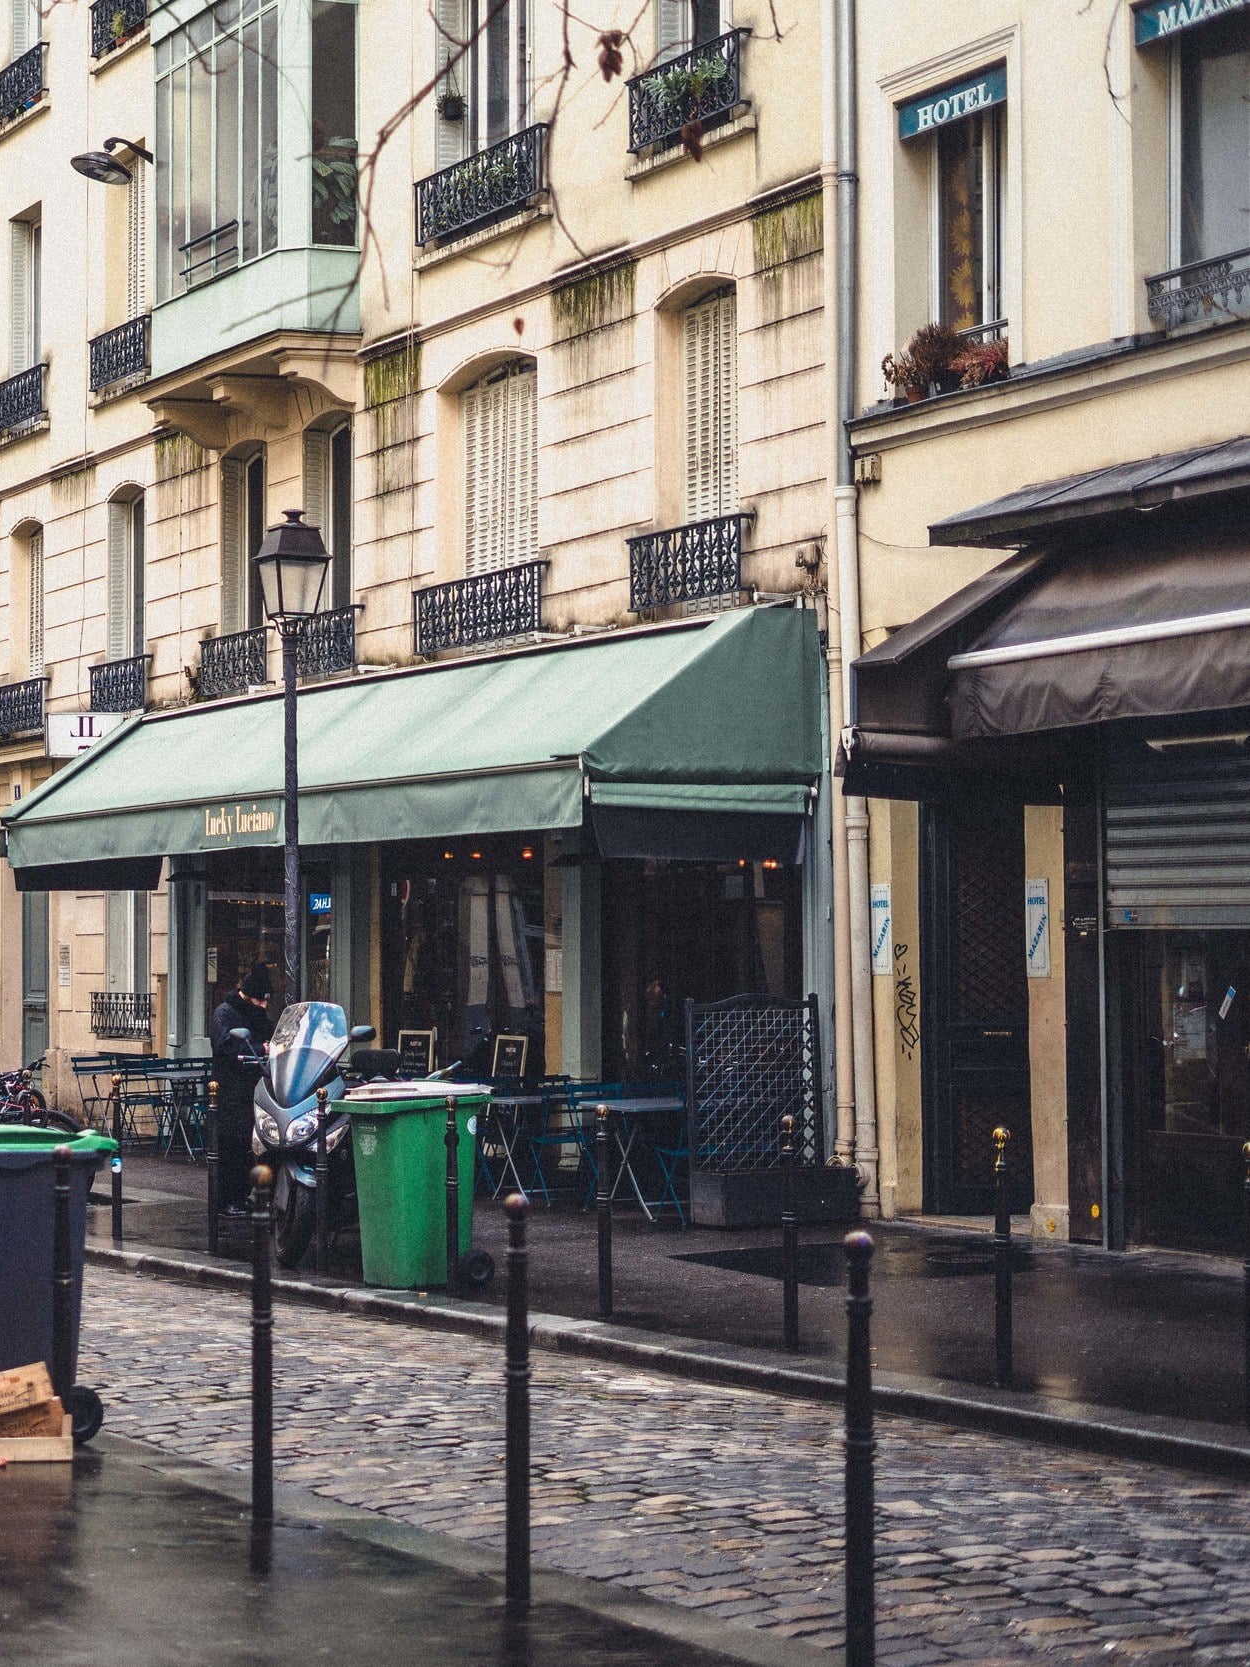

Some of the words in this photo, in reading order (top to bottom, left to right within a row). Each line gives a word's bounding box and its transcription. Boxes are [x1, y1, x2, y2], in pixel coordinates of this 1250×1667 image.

[1158, 0, 1245, 36] MAZA
[917, 82, 992, 131] HOTEL
[205, 807, 233, 842] Lucky
[235, 804, 274, 833] Luciano
[872, 899, 890, 909] HOTEL
[1027, 896, 1047, 905] HOTEL
[873, 916, 890, 959] MAZARIN
[1028, 914, 1047, 959] MAZARIN
